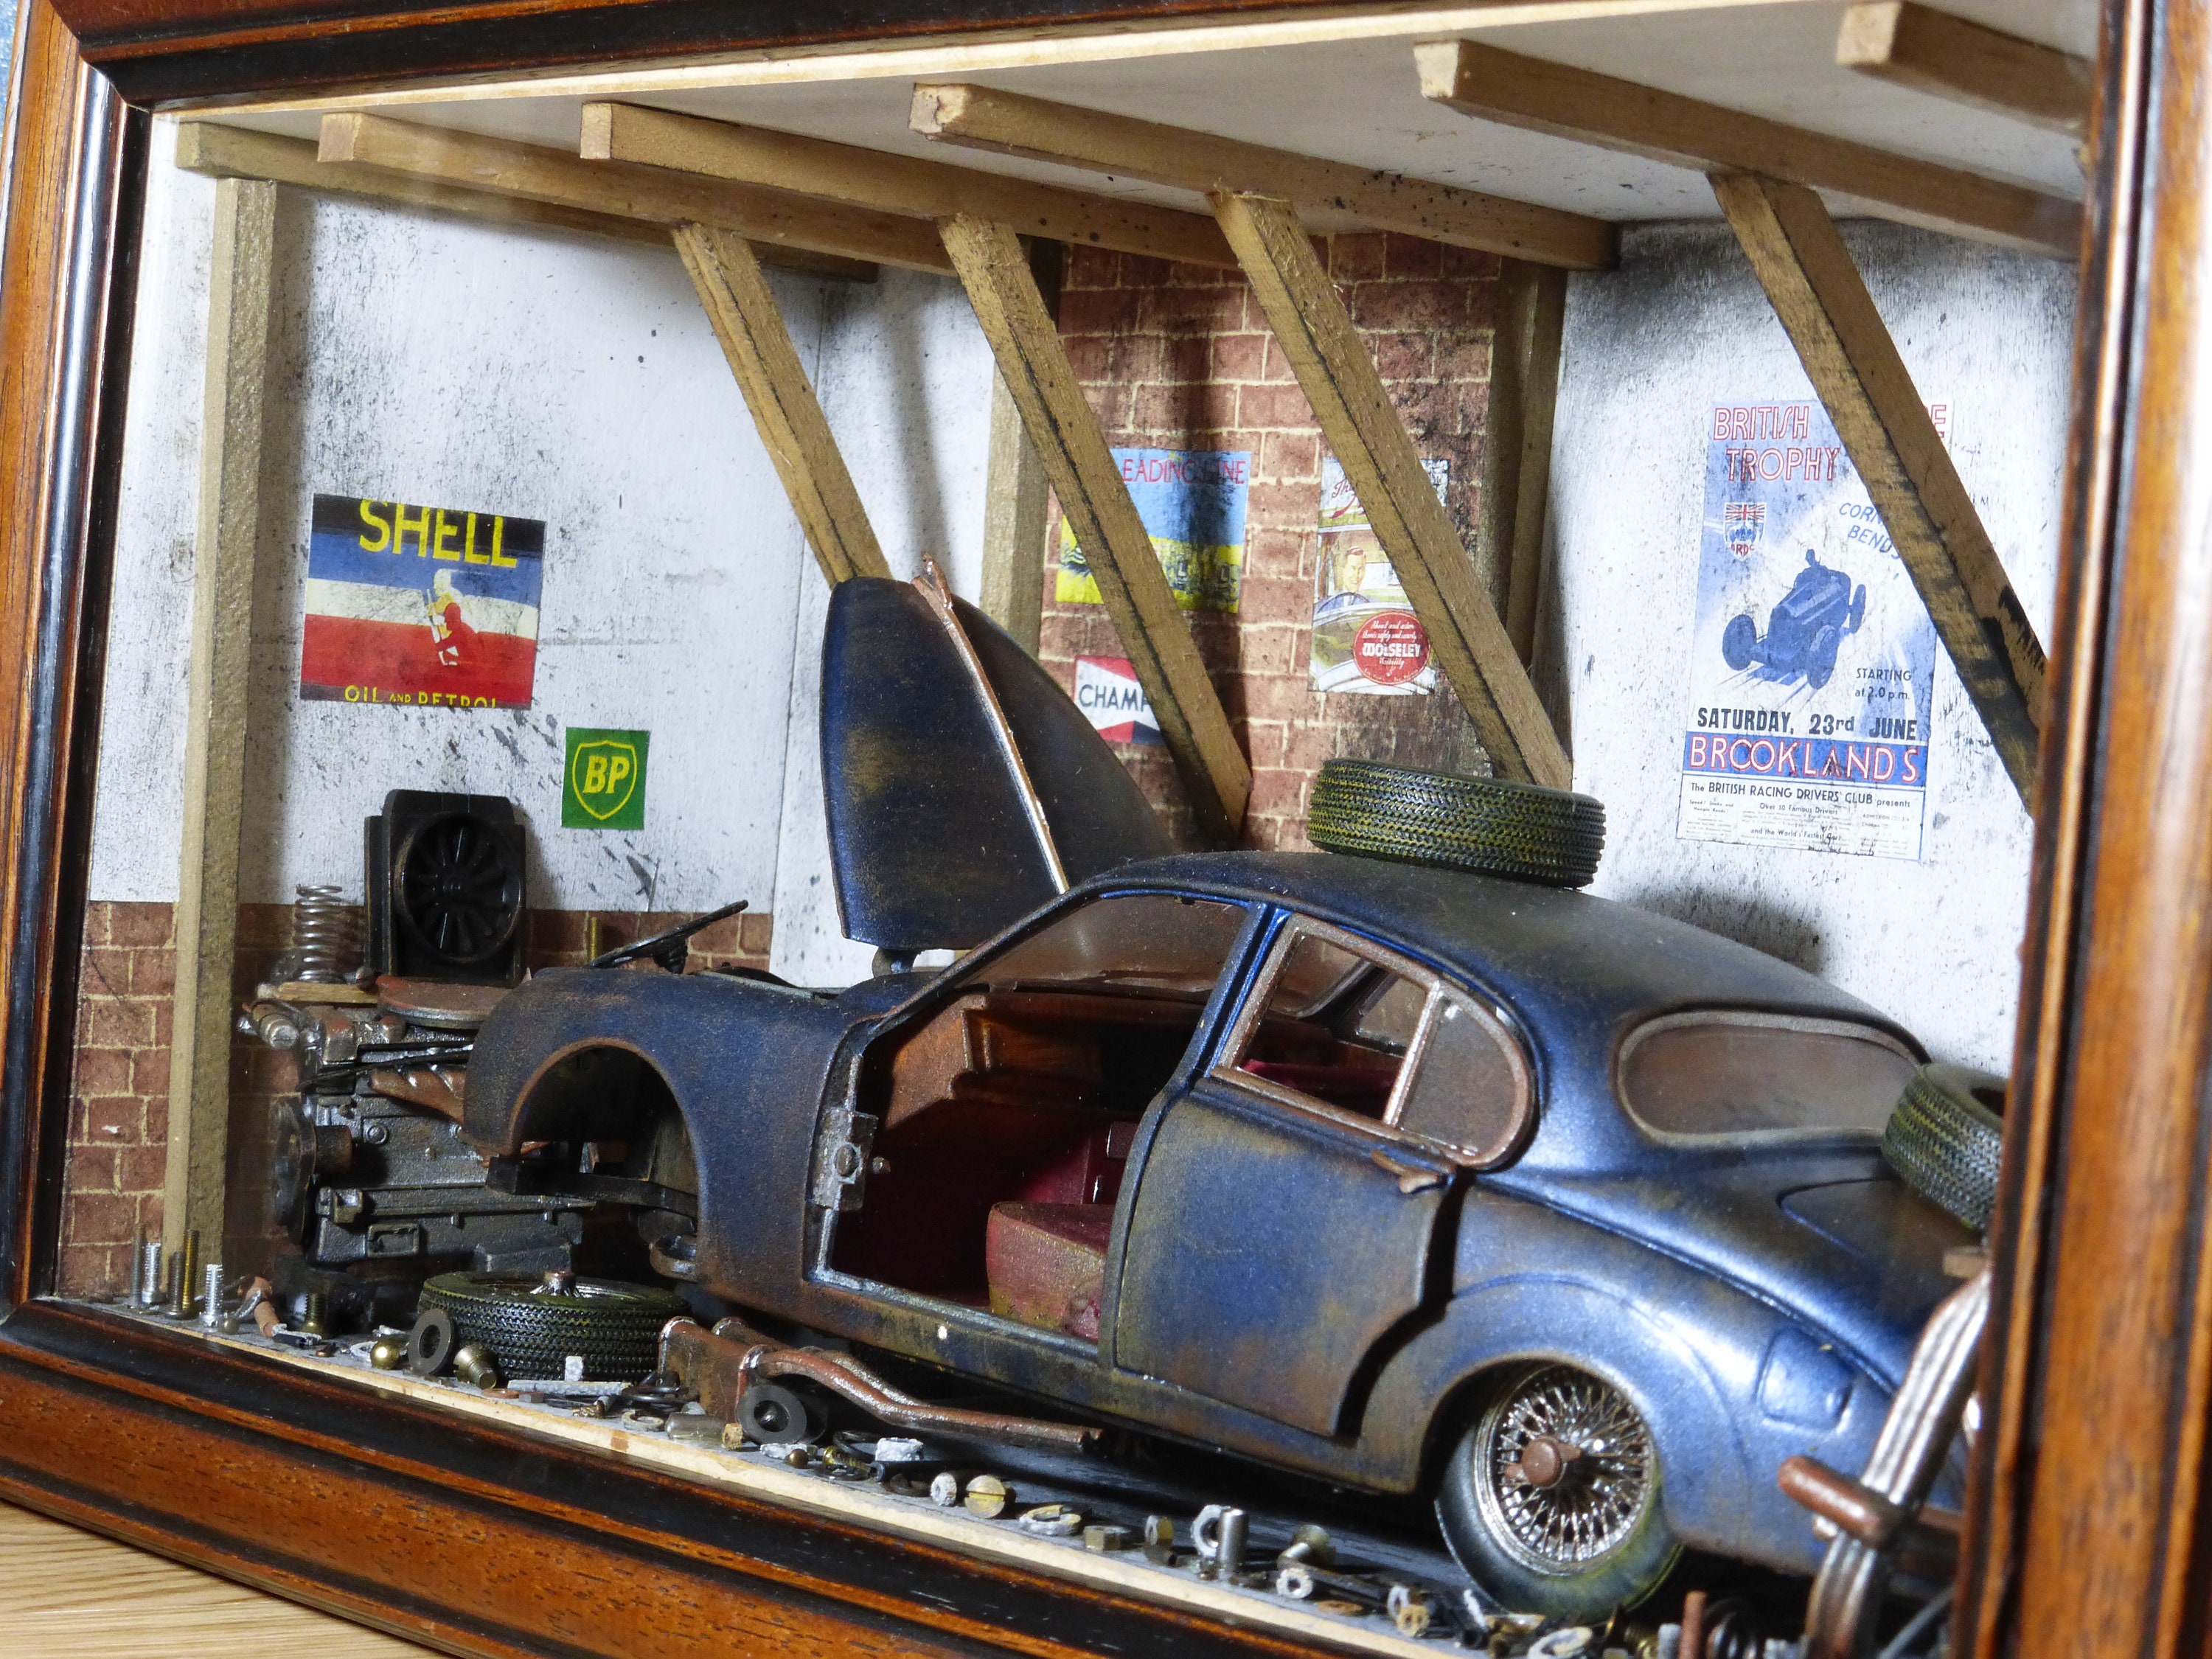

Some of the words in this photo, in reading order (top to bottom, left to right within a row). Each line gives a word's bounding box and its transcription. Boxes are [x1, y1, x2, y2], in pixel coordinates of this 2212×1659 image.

[1714, 406, 1809, 440] BRITISH
[1122, 459, 1195, 484] EADING
[1726, 447, 1840, 481] TROPHY
[358, 498, 517, 568] SHELL
[1362, 642, 1421, 658] WOLSELEY
[1856, 668, 1912, 681] STARTING
[344, 685, 383, 703] OIL
[389, 693, 411, 703] AND
[1697, 707, 1794, 734] SATURDAY,
[1809, 714, 1855, 735] 23rd
[1869, 717, 1917, 740] JUNE
[1688, 735, 1920, 783] BROOKLANDS
[583, 755, 630, 794] BP
[1691, 782, 1705, 792] The
[1708, 782, 1746, 796] BRITISH
[1750, 785, 1792, 799] RACING
[1845, 792, 1873, 804] CLUB
[1877, 798, 1910, 808] presents
[1759, 802, 1775, 810] Over
[1788, 804, 1812, 813] Famous
[1815, 807, 1838, 815] Drivers
